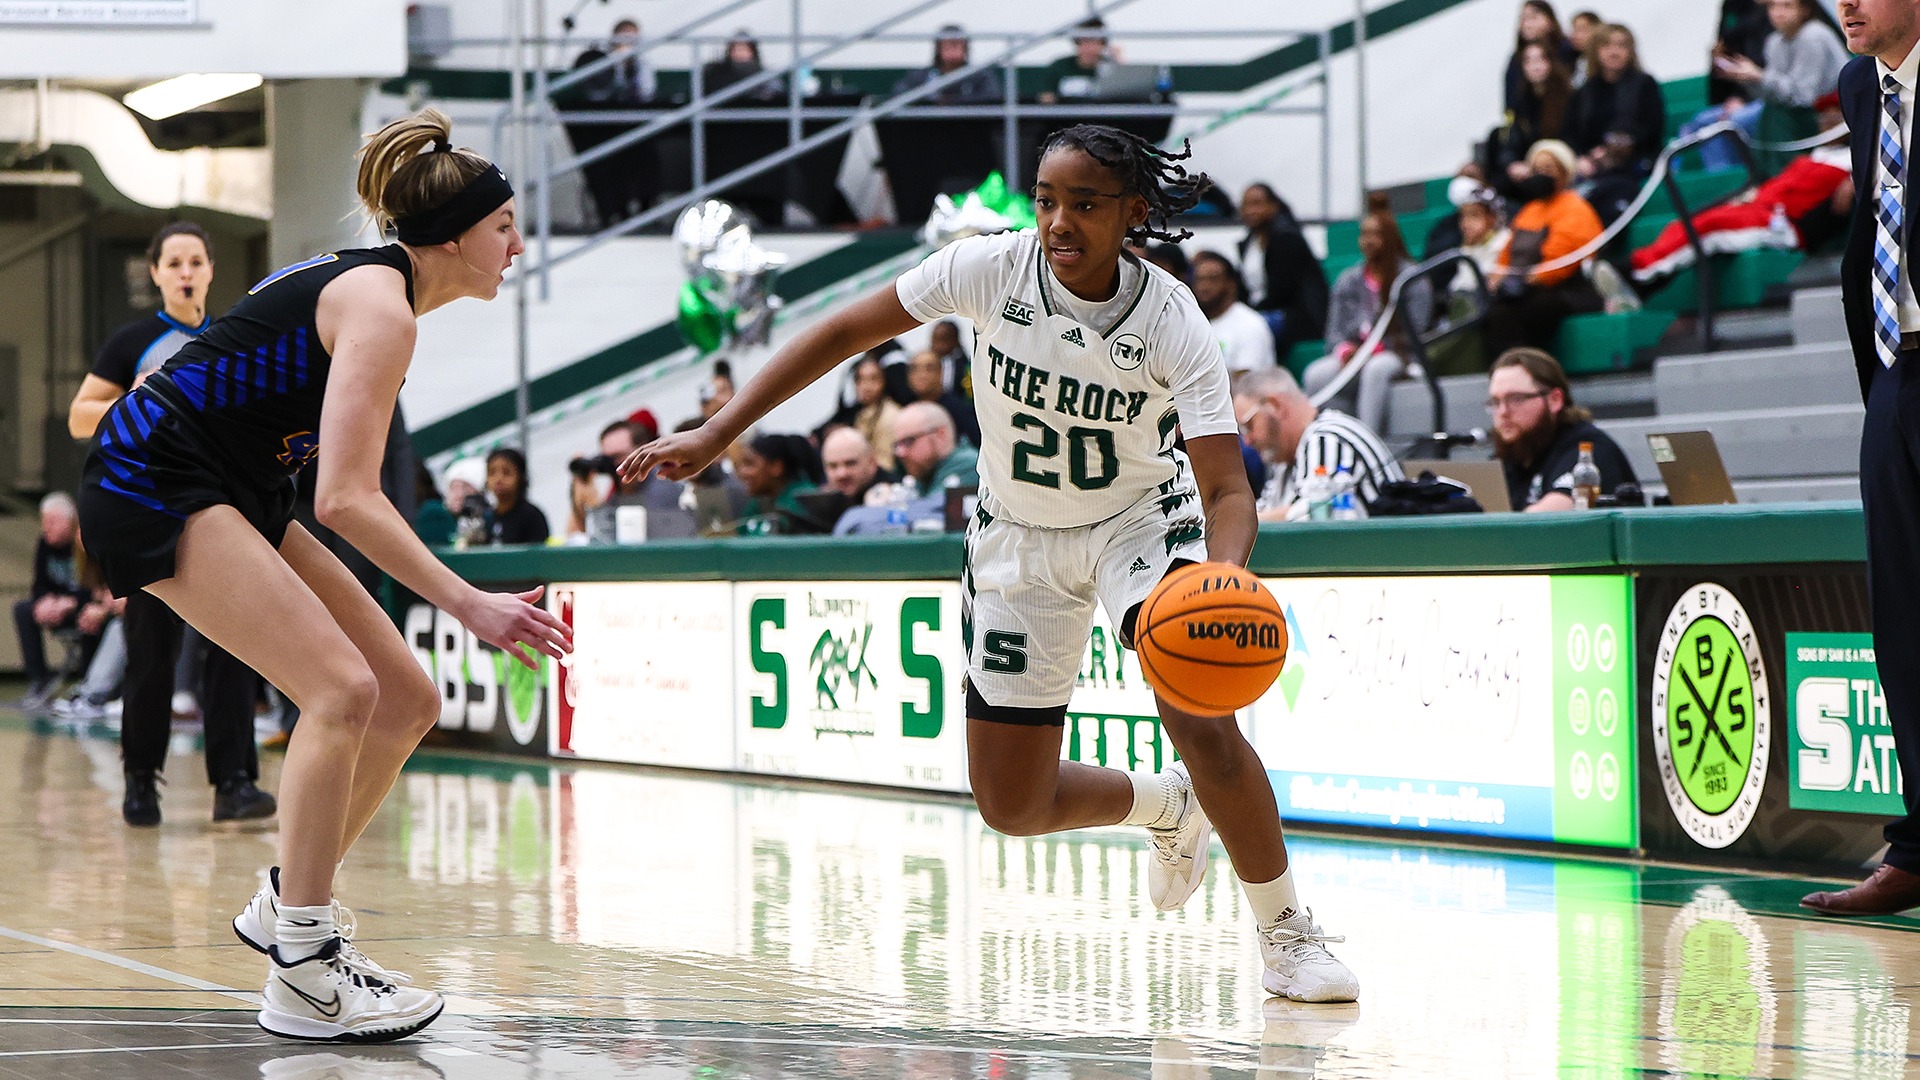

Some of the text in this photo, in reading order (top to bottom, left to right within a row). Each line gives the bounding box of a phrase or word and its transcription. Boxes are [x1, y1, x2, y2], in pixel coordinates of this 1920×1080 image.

[1061, 333, 1086, 349] adidas
[988, 343, 1050, 410] THE
[1011, 411, 1121, 490] 20
[749, 595, 789, 730] S
[900, 594, 945, 739] S
[981, 629, 1028, 676] S
[1187, 621, 1280, 649] Wilson
[1695, 634, 1714, 679] B
[1699, 590, 1721, 609] BY
[1731, 609, 1761, 681] SAM
[1676, 686, 1746, 748] S S
[1796, 676, 1892, 791] S TH
